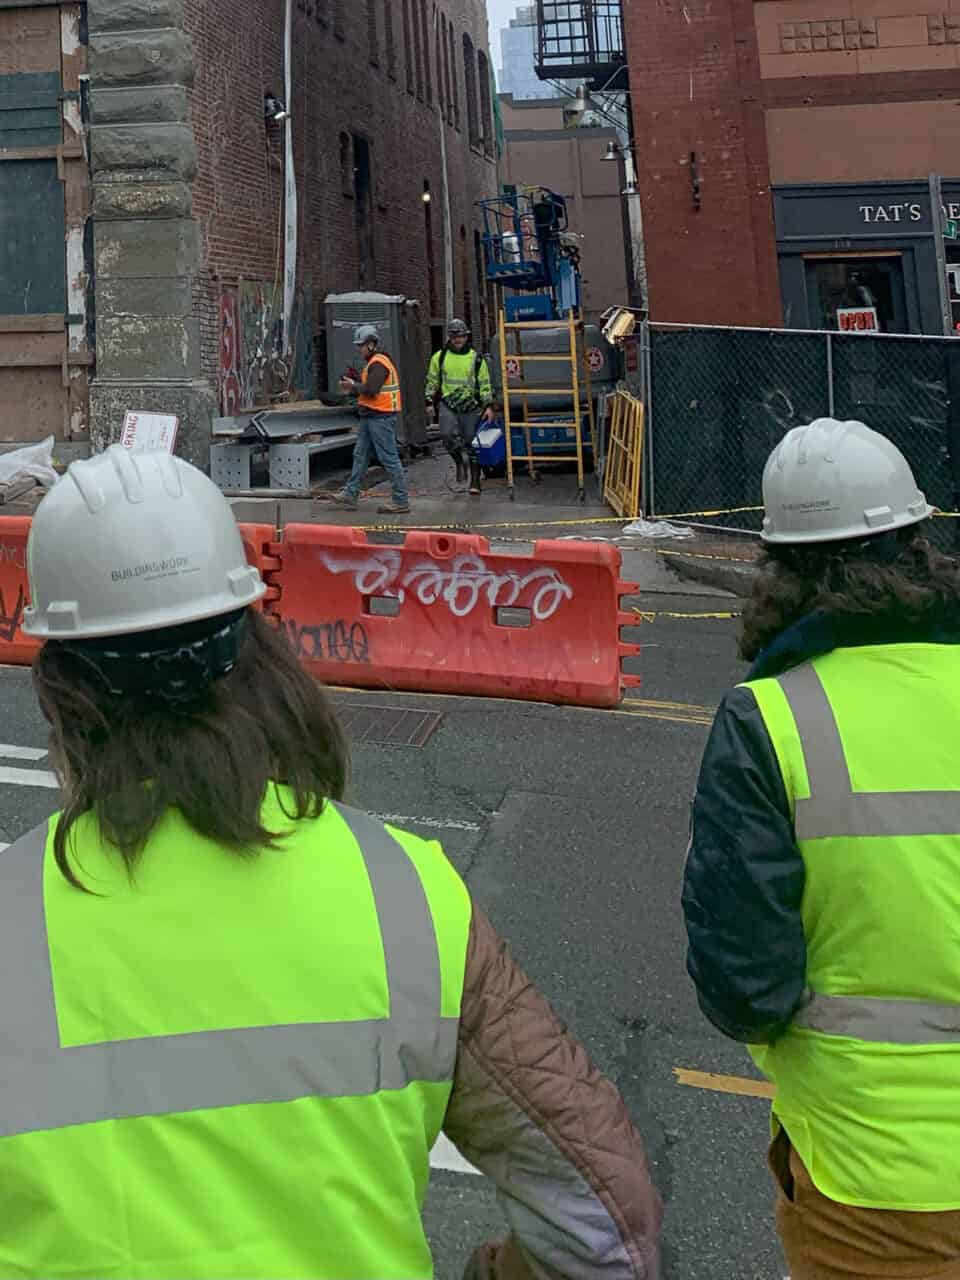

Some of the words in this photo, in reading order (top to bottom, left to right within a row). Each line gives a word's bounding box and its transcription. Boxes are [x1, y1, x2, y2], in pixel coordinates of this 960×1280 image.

[859, 203, 921, 222] TAT'S
[839, 311, 874, 331] OPEN
[123, 415, 139, 449] RKING
